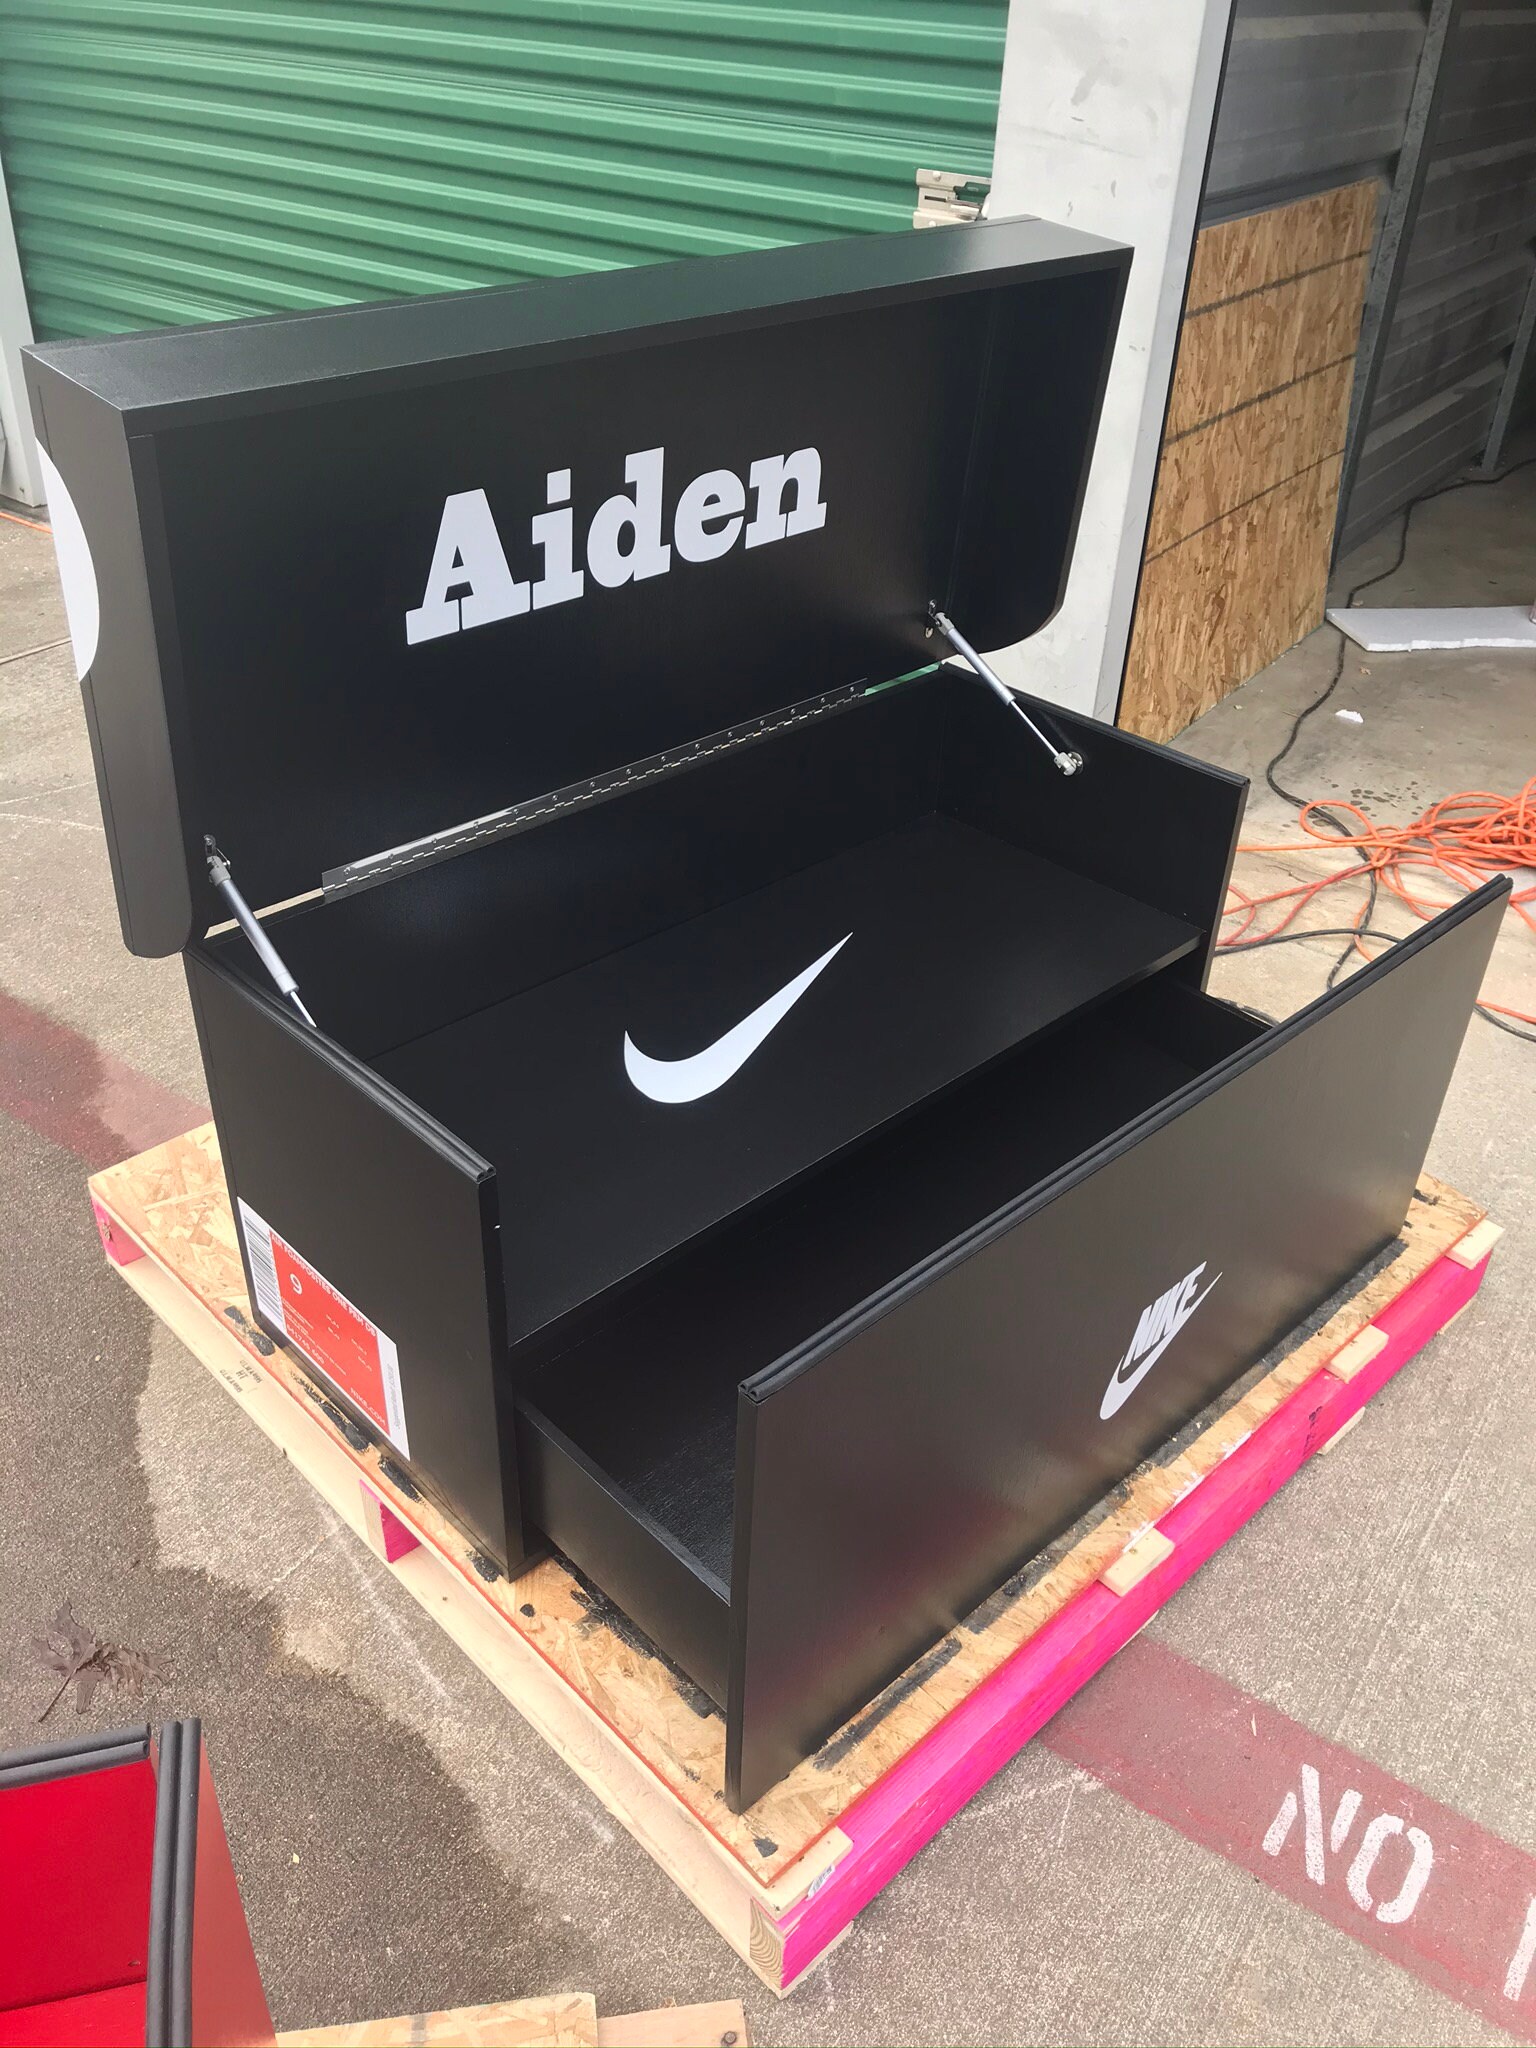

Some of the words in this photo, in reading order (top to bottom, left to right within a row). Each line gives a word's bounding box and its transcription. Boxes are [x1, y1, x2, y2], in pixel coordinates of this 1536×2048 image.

[405, 446, 828, 646] Aiden
[272, 1233, 284, 1249] AIR
[332, 1292, 348, 1311] ONE
[289, 1273, 303, 1295] 9
[1121, 1260, 1207, 1371] NIKE
[350, 1387, 386, 1426] NIKE.COM
[1262, 1763, 1434, 1924] NO
